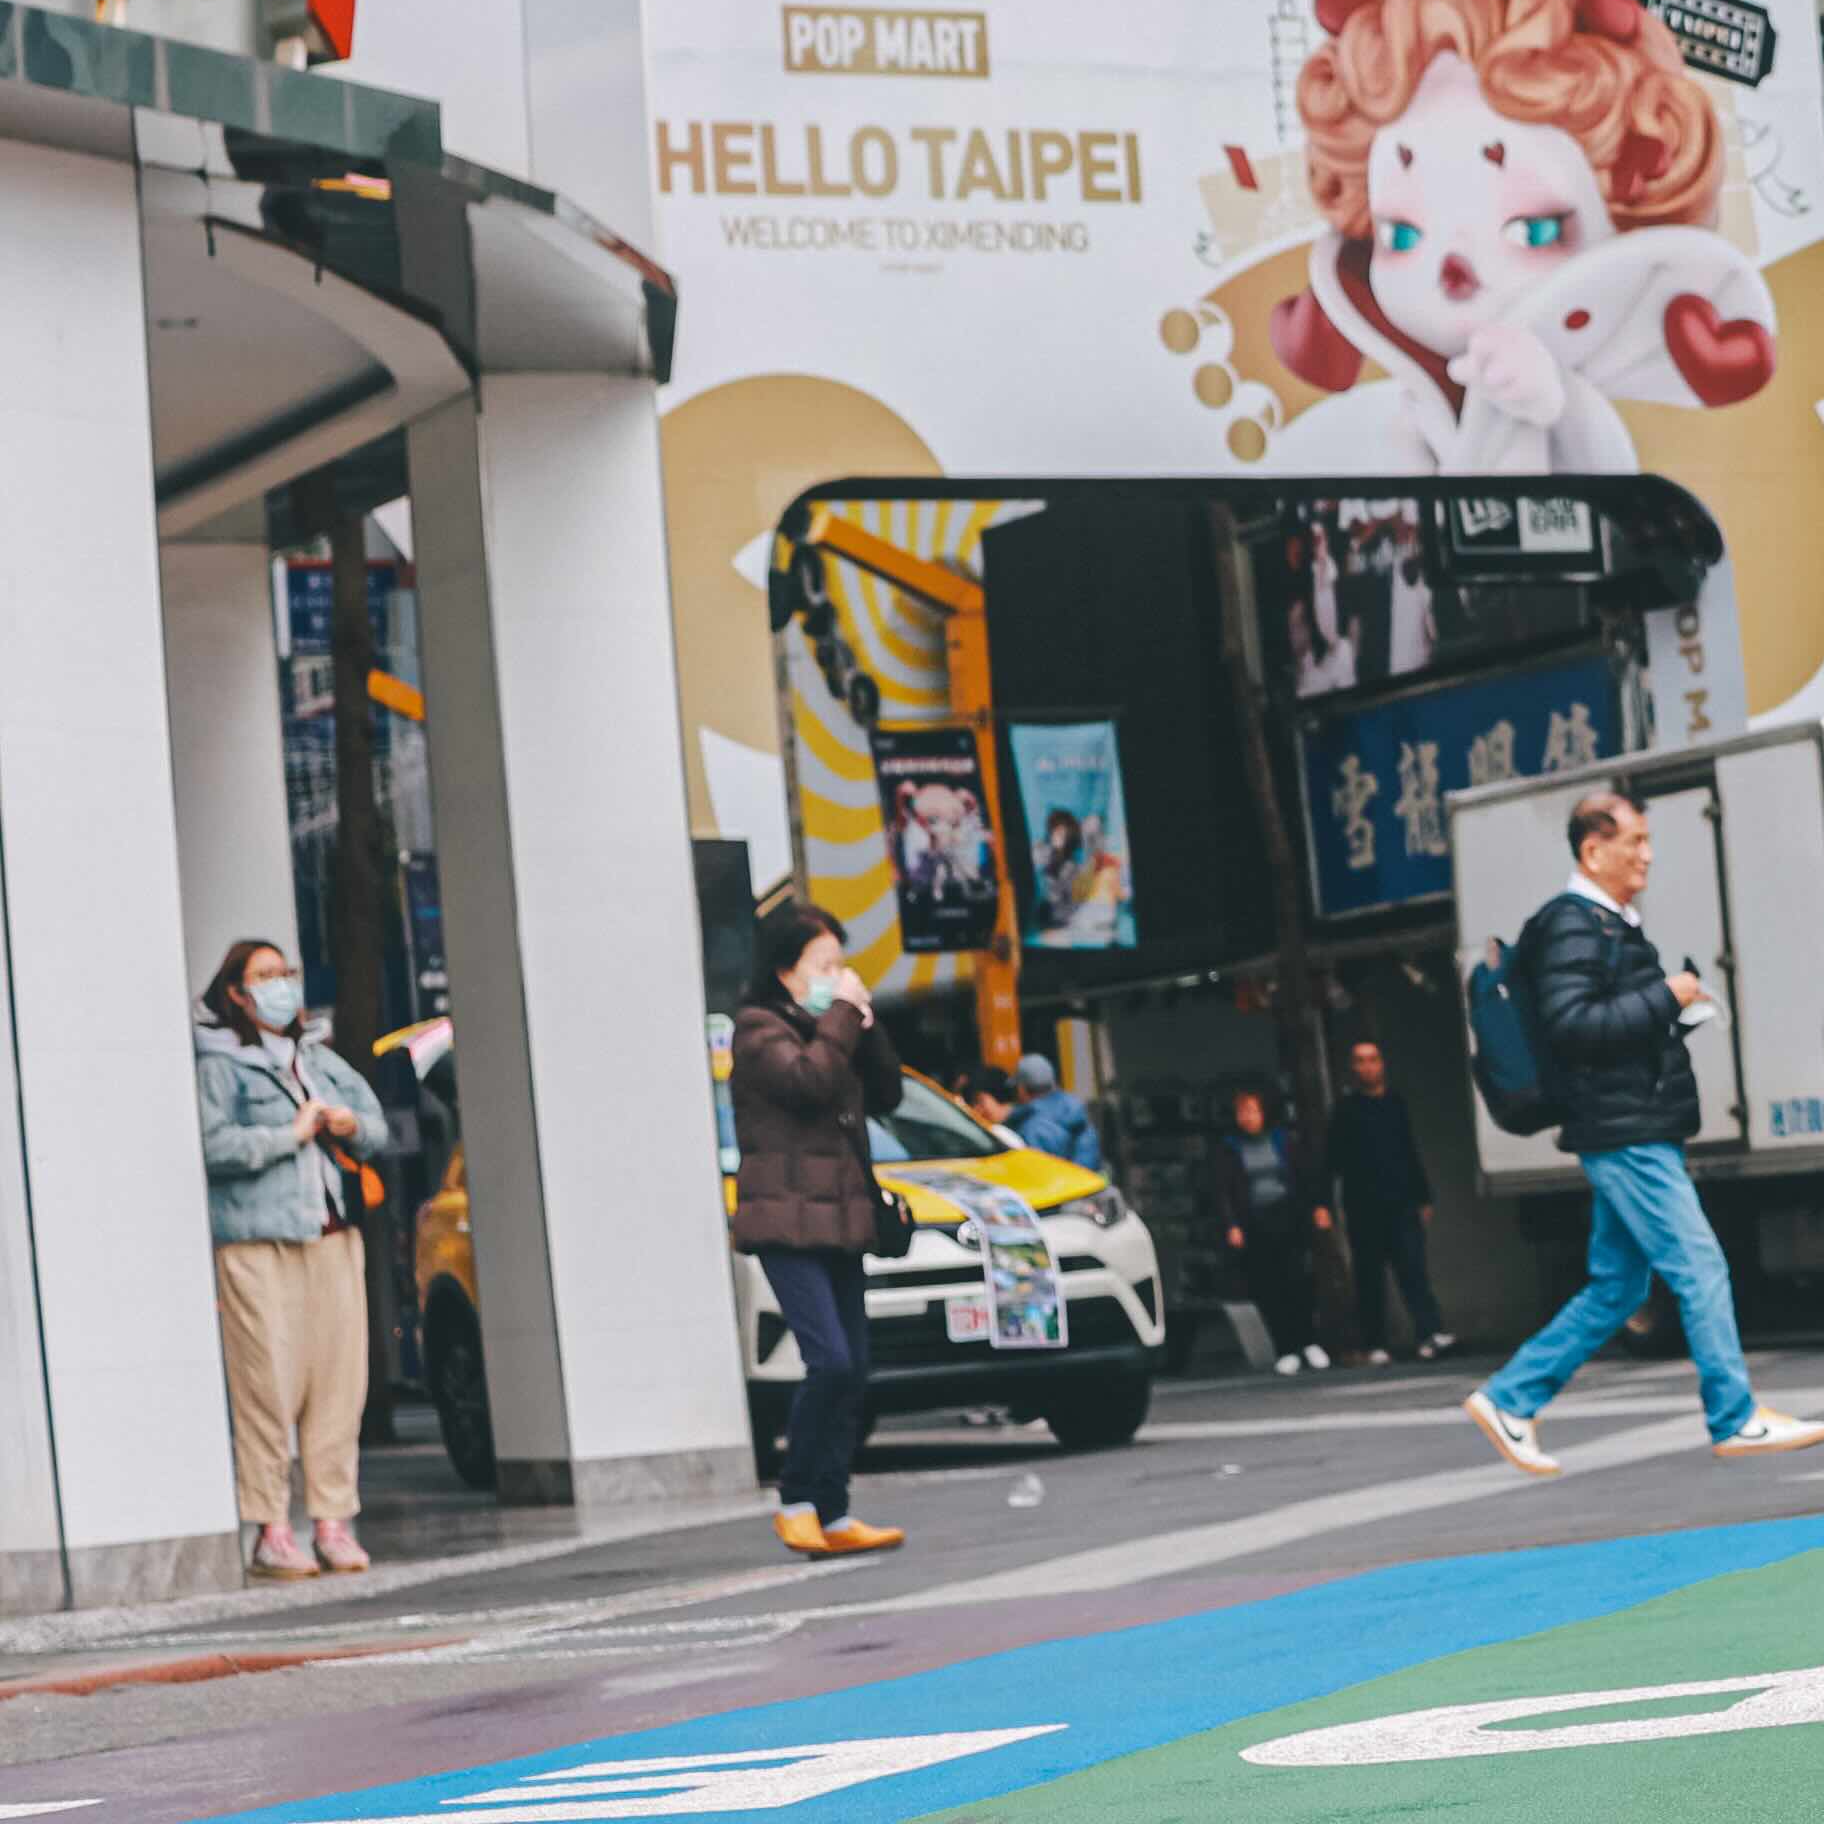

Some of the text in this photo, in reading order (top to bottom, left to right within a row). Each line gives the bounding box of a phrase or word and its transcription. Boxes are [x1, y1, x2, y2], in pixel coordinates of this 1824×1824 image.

[788, 12, 979, 72] POP MART
[656, 121, 1143, 204] HELLO TAIPEI
[720, 215, 1089, 254] WELCOME TO XIMENDING
